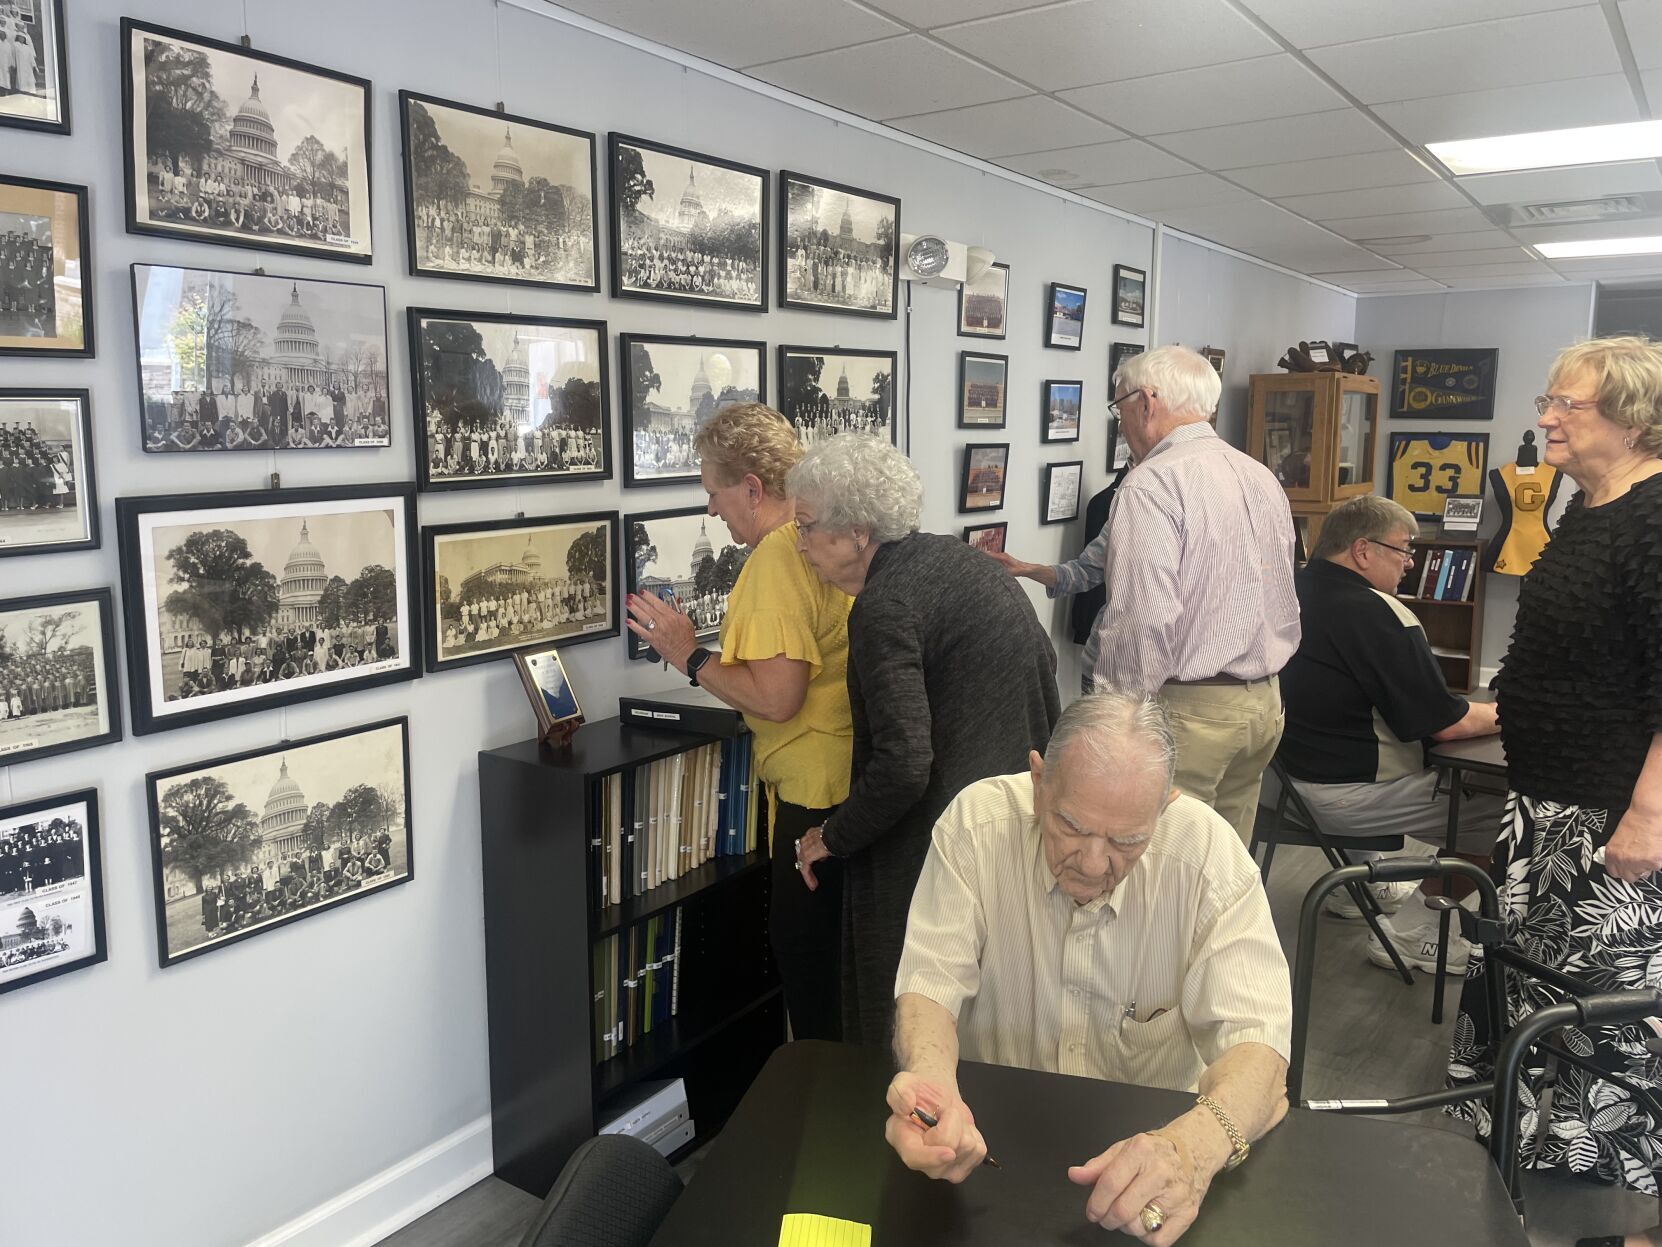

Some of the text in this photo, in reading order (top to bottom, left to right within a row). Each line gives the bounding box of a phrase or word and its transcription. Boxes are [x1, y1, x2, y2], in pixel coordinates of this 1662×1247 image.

[1428, 362, 1451, 378] BLUE
[1407, 461, 1462, 494] 33
[1514, 482, 1546, 512] G
